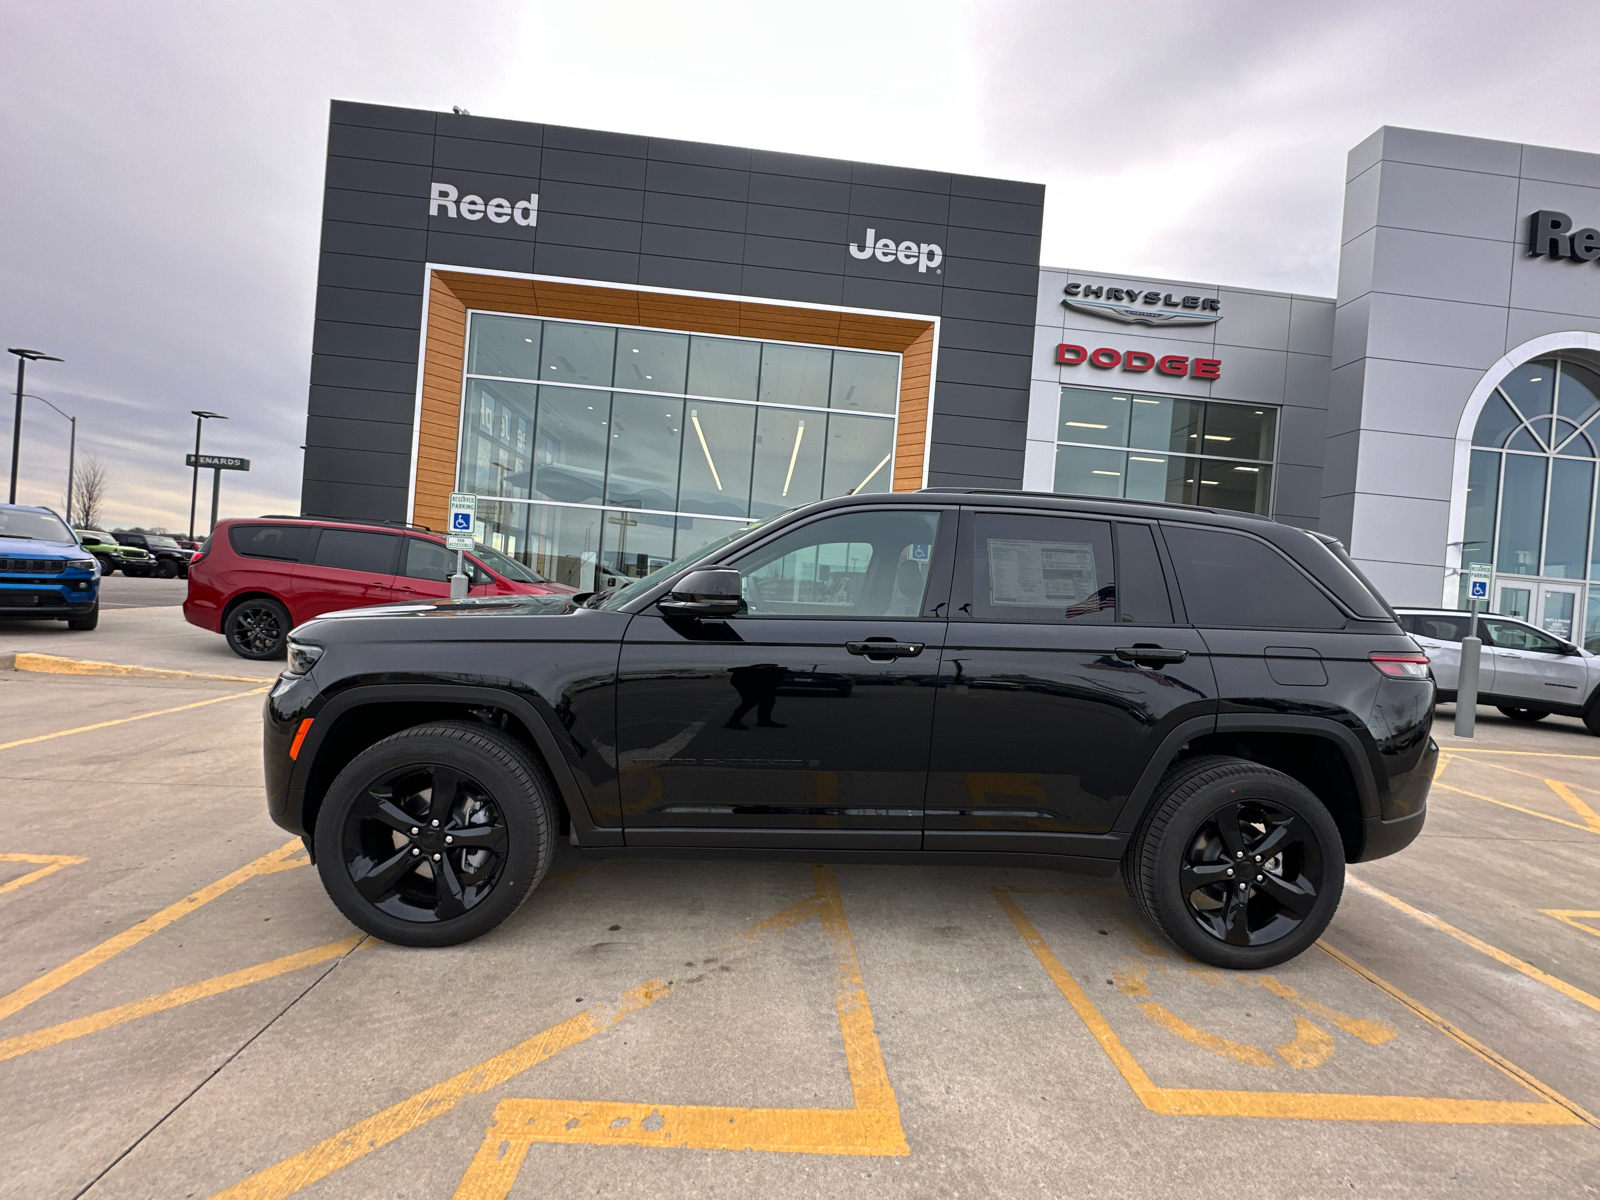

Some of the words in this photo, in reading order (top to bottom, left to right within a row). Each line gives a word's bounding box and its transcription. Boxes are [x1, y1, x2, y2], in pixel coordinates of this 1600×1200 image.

[429, 182, 539, 228] Reed
[849, 227, 942, 273] Jeep
[1064, 282, 1221, 311] CHRYSLER
[1055, 343, 1221, 379] DODGE
